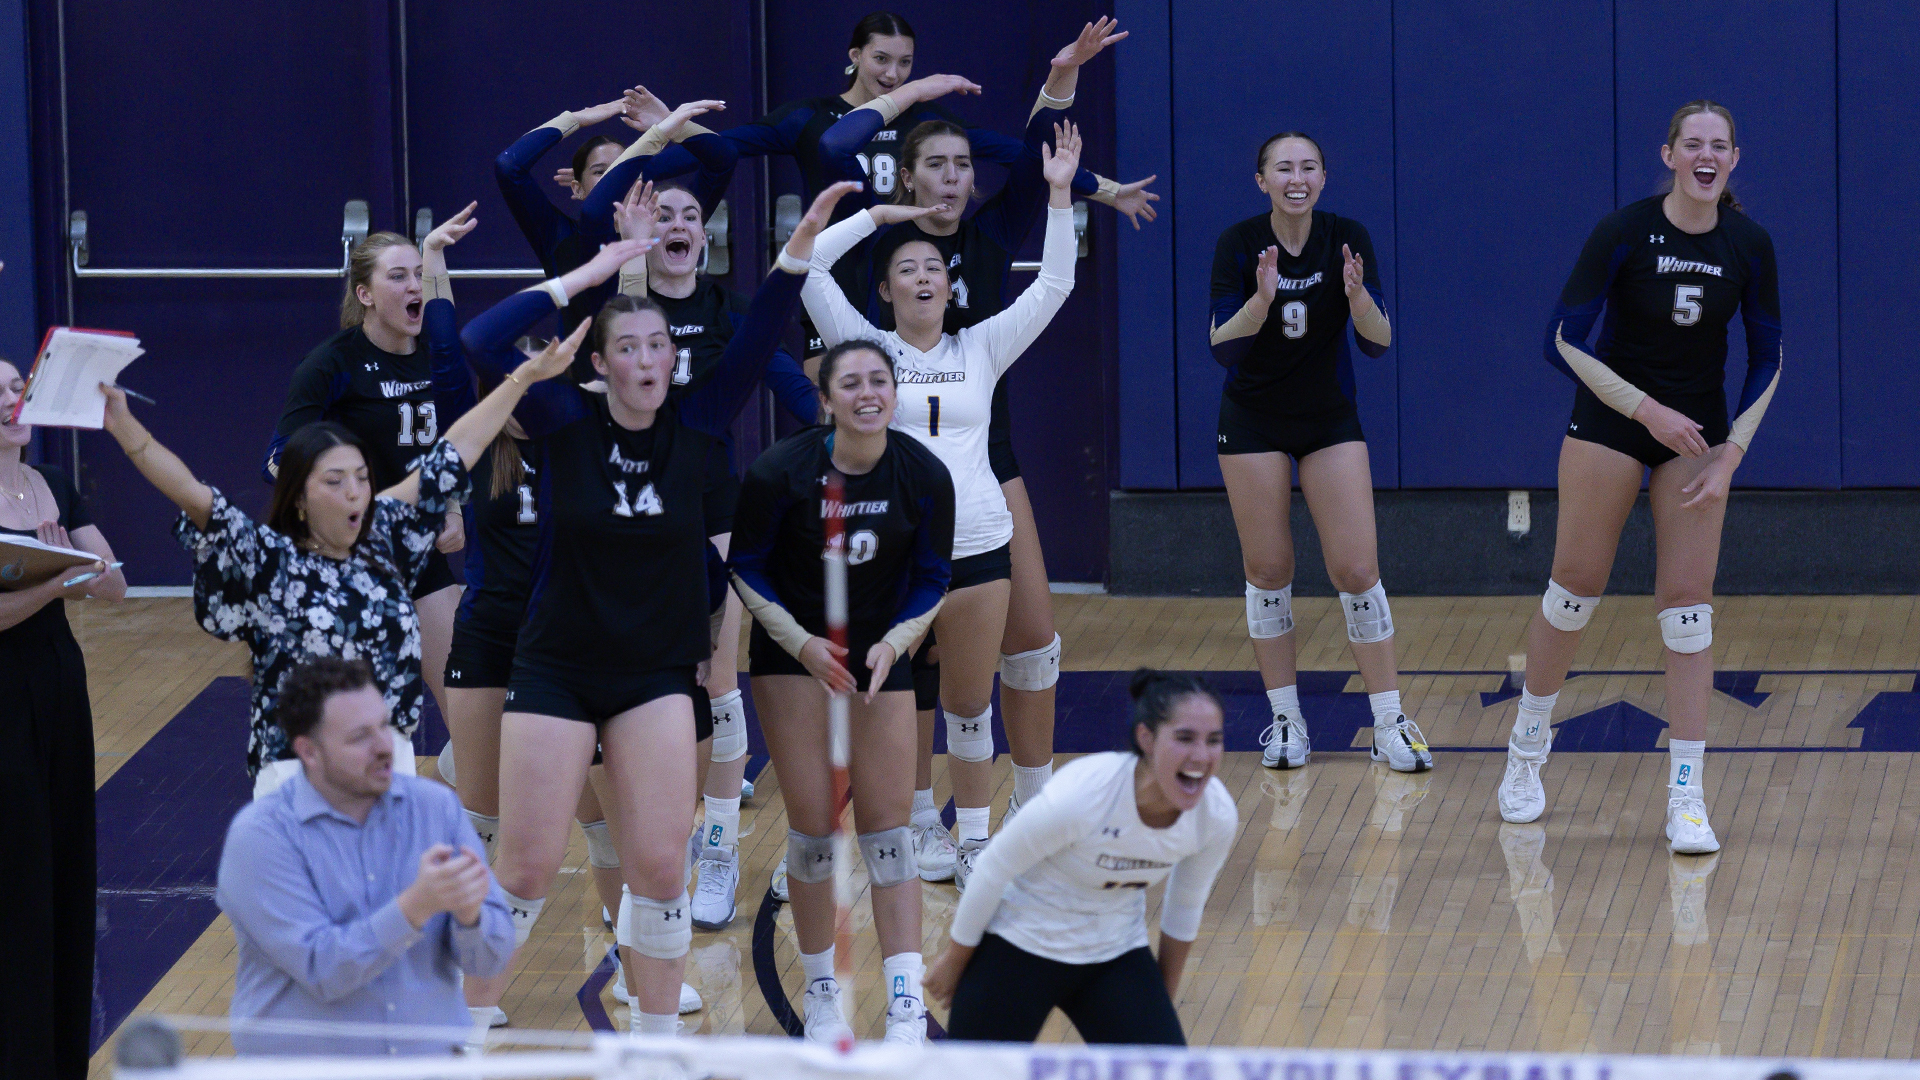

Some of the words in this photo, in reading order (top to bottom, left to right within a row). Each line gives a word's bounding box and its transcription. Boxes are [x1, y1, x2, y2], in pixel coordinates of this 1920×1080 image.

[1277, 271, 1323, 290] HITTIER
[1656, 255, 1723, 277] WHITTIER
[1281, 300, 1308, 340] 9
[1671, 284, 1704, 327] 5
[896, 366, 966, 384] WHITTIER
[397, 400, 438, 446] 13
[927, 395, 940, 437] 1
[612, 480, 665, 518] 14
[820, 499, 889, 519] WHITTIER
[820, 529, 880, 566] 10
